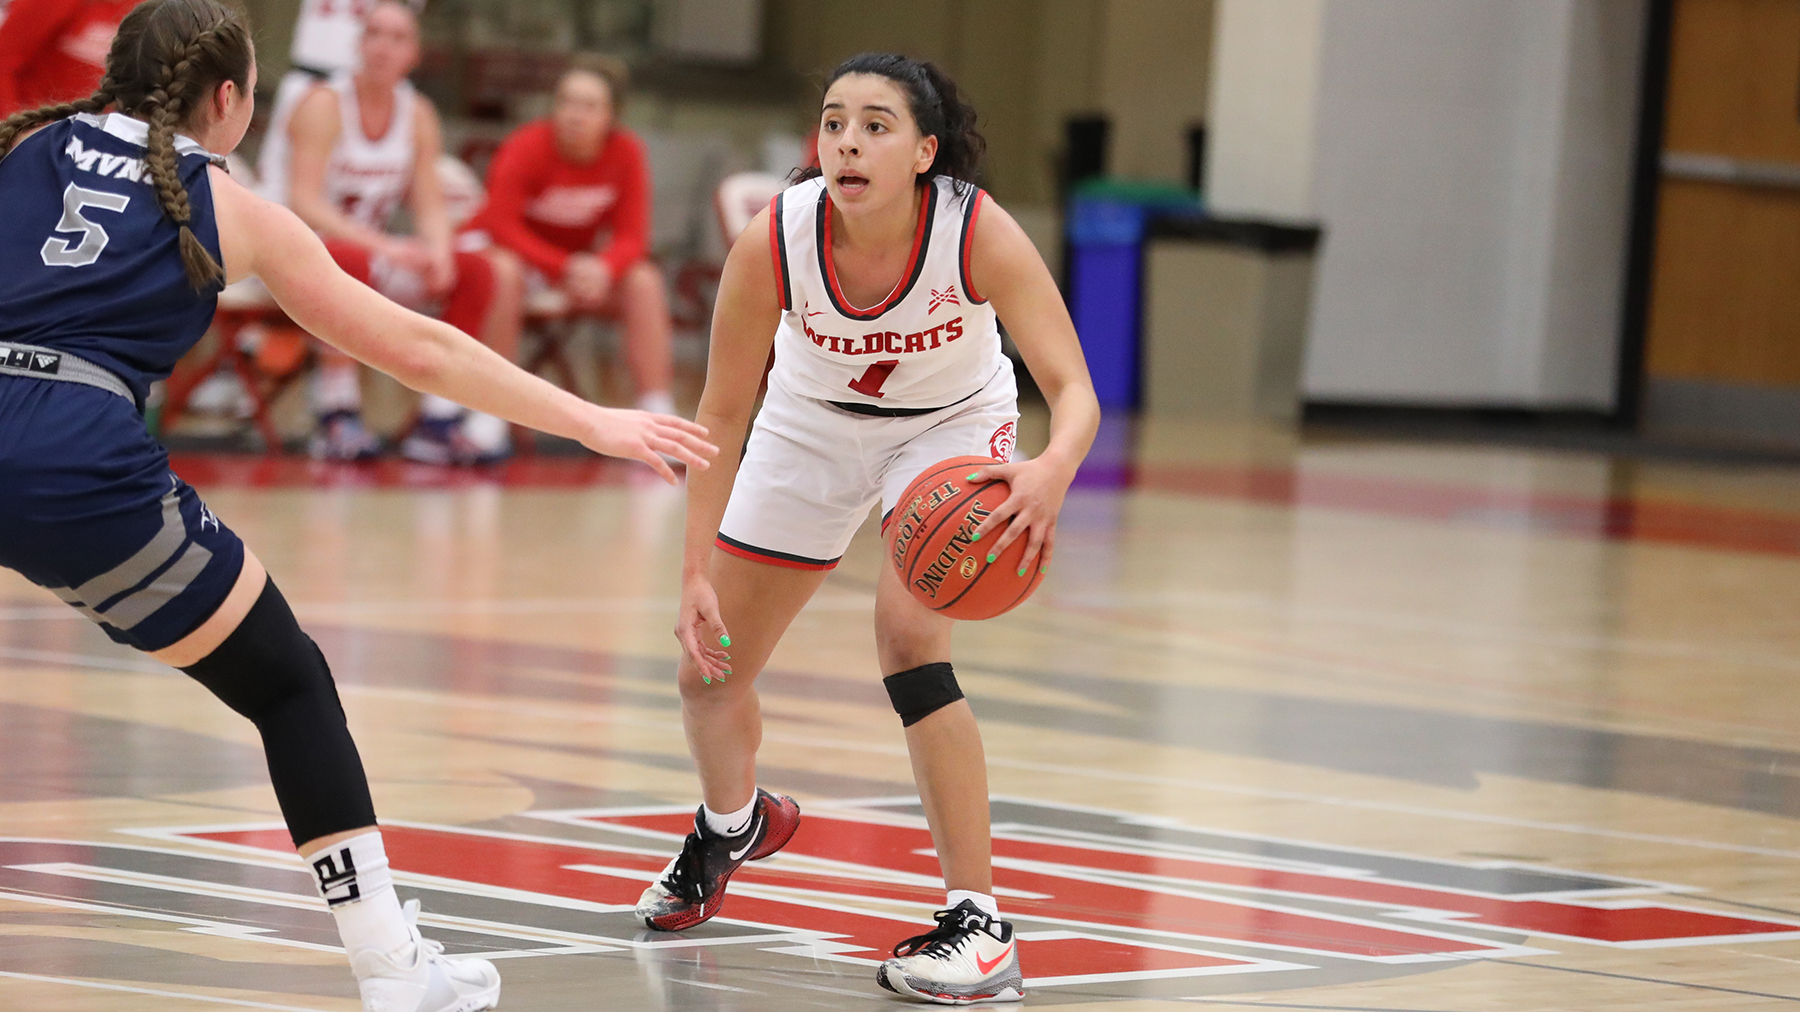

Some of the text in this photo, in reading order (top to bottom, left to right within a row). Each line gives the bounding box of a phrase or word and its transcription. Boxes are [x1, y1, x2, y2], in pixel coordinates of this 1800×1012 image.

[65, 135, 154, 187] MVN
[40, 181, 131, 268] 5
[801, 316, 964, 356] WILDCATS
[847, 359, 900, 398] 1
[895, 481, 961, 569] TF-1000
